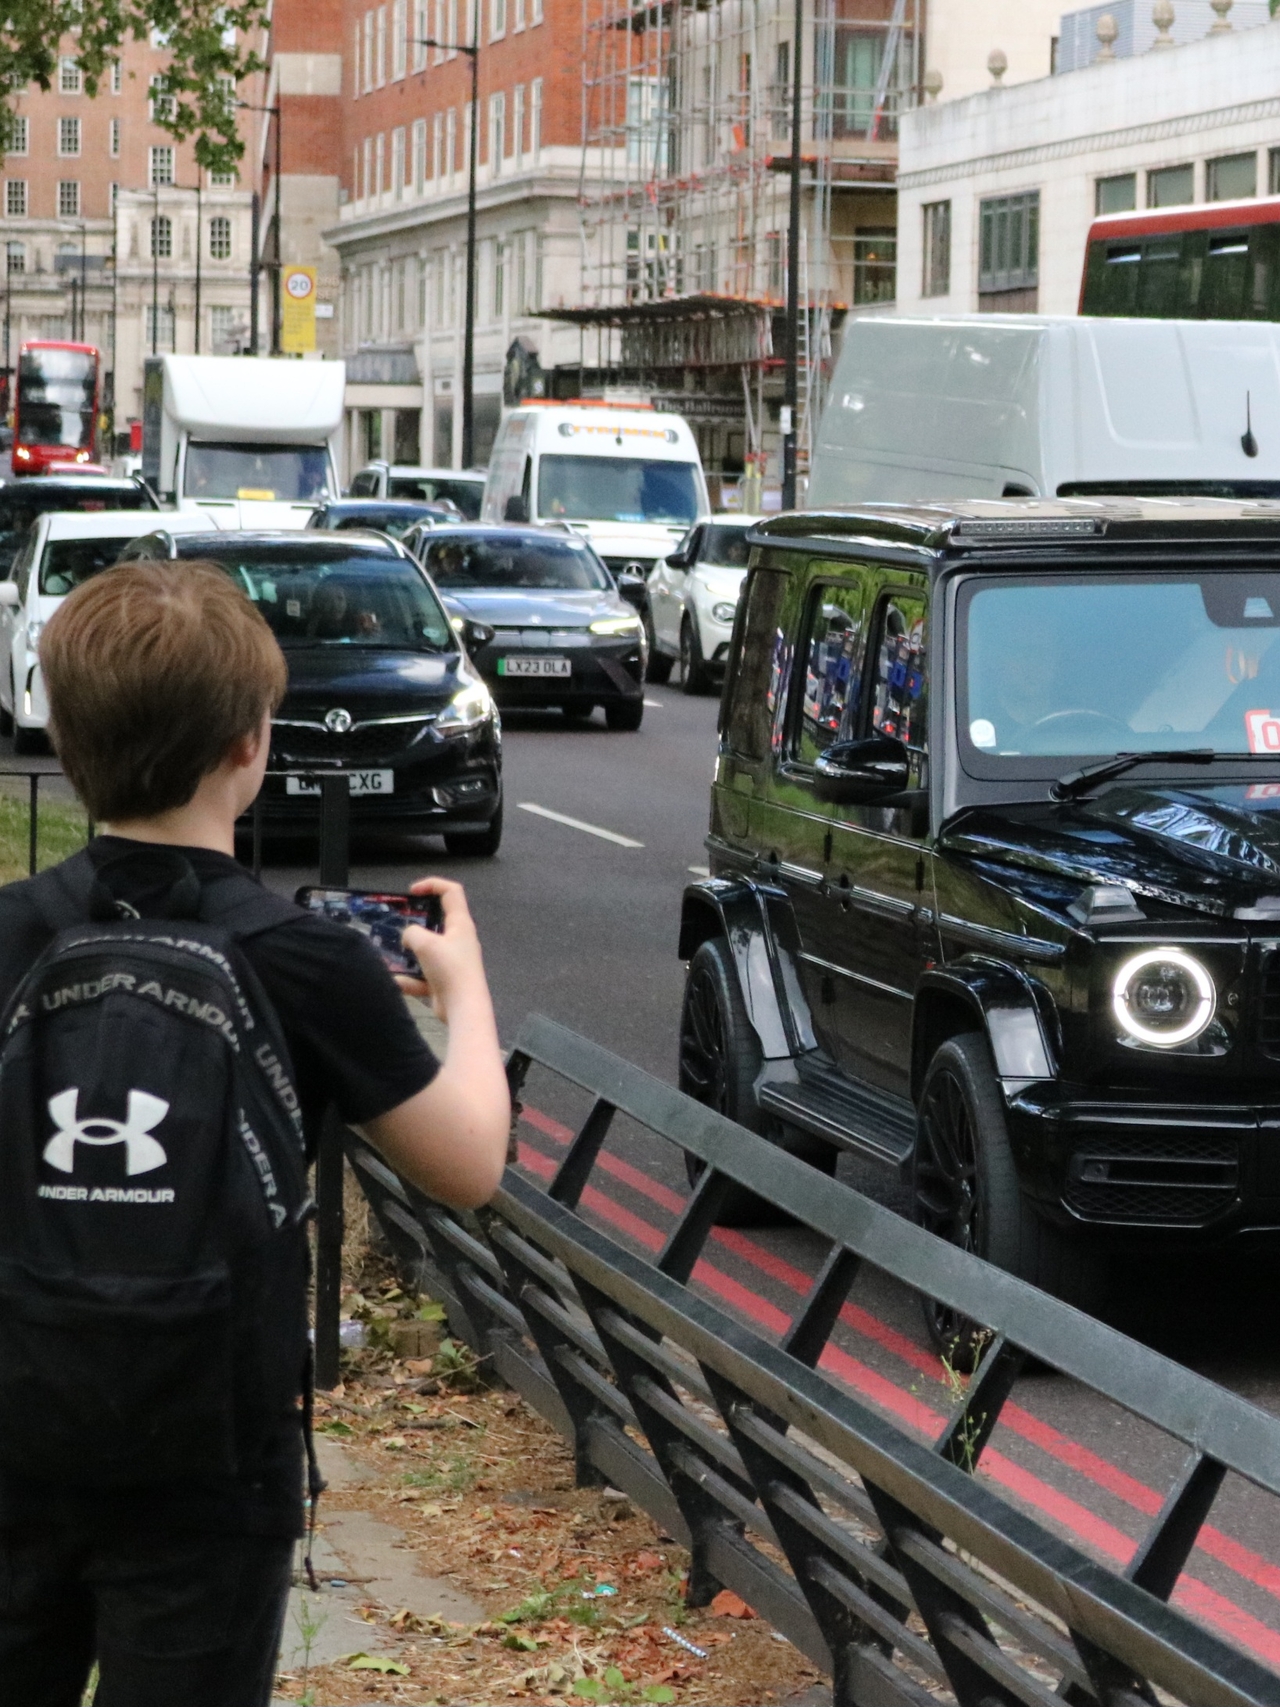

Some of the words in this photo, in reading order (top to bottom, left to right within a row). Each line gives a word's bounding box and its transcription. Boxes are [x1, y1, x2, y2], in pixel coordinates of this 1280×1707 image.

[290, 280, 309, 291] 20
[506, 661, 540, 673] LX23
[43, 973, 136, 1010] UNDER
[89, 1187, 175, 1203] ARMOUR
